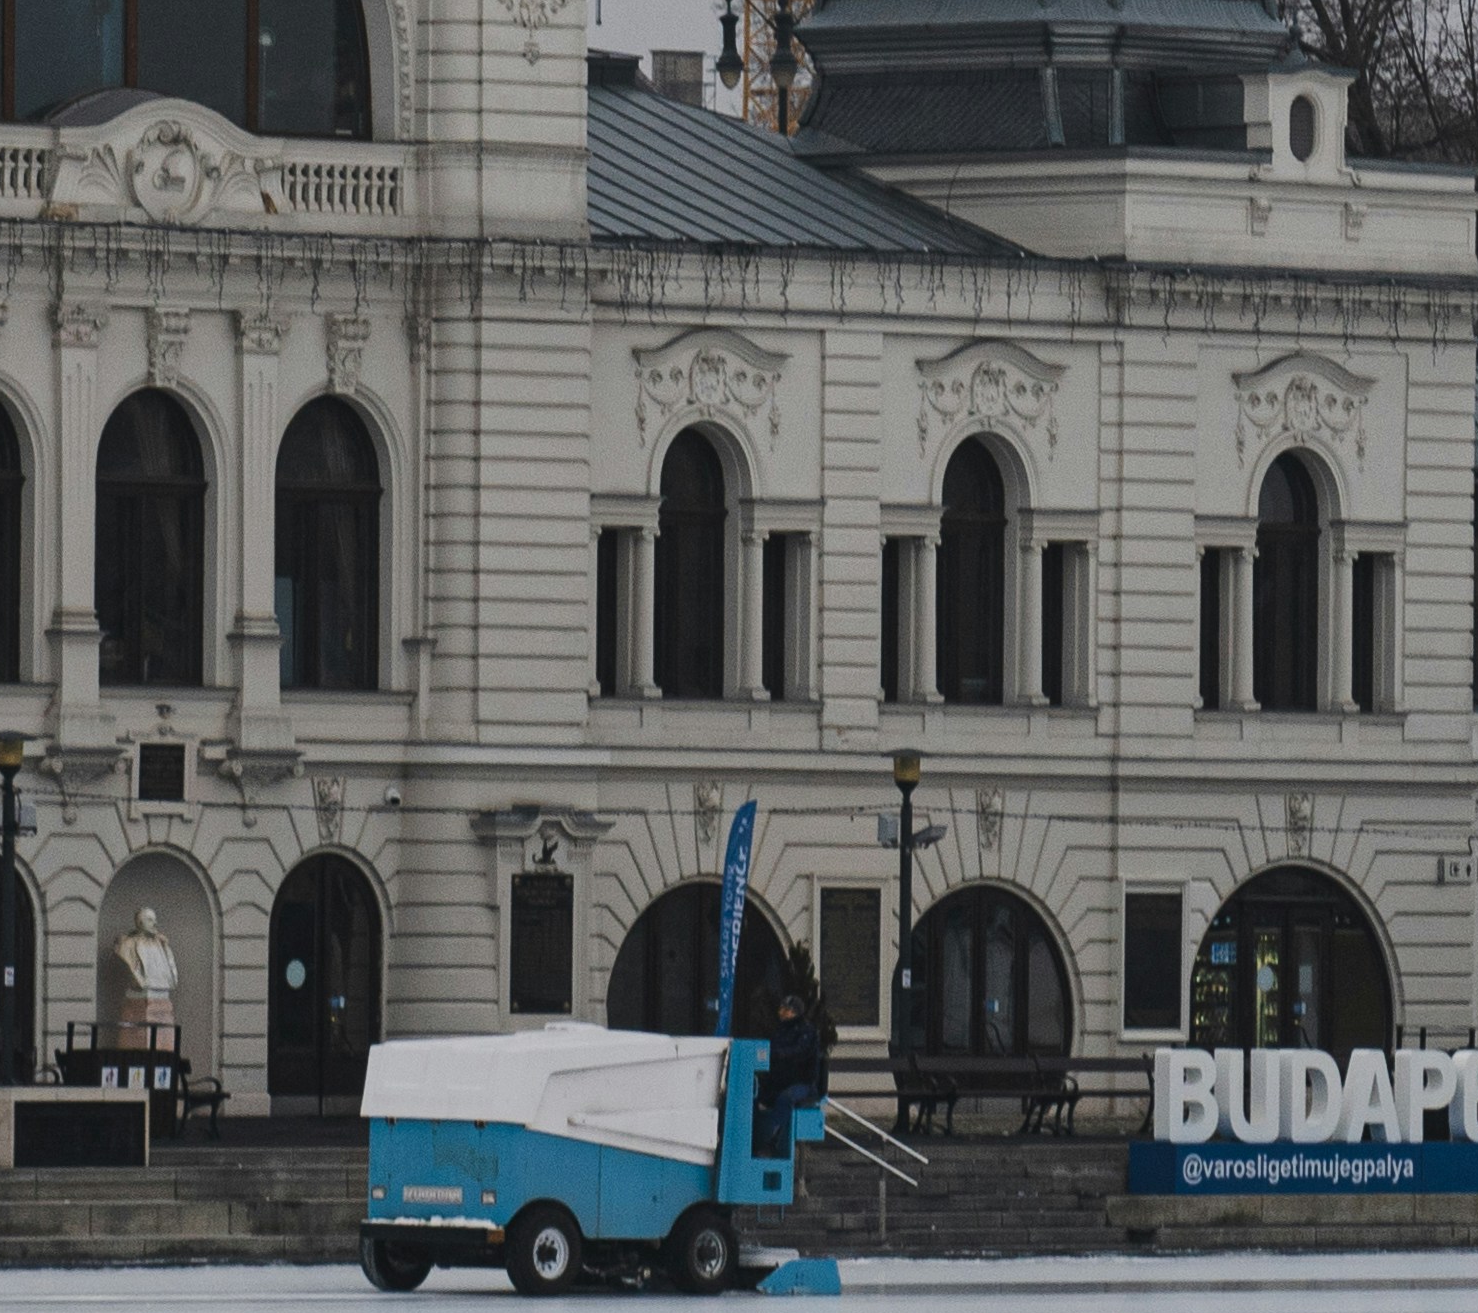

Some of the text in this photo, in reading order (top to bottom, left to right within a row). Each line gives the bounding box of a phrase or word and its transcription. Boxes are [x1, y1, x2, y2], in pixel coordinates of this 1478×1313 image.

[721, 864, 737, 978] SHARE YOUR
[1182, 1151, 1414, 1186] @varosligetimujegpalya
